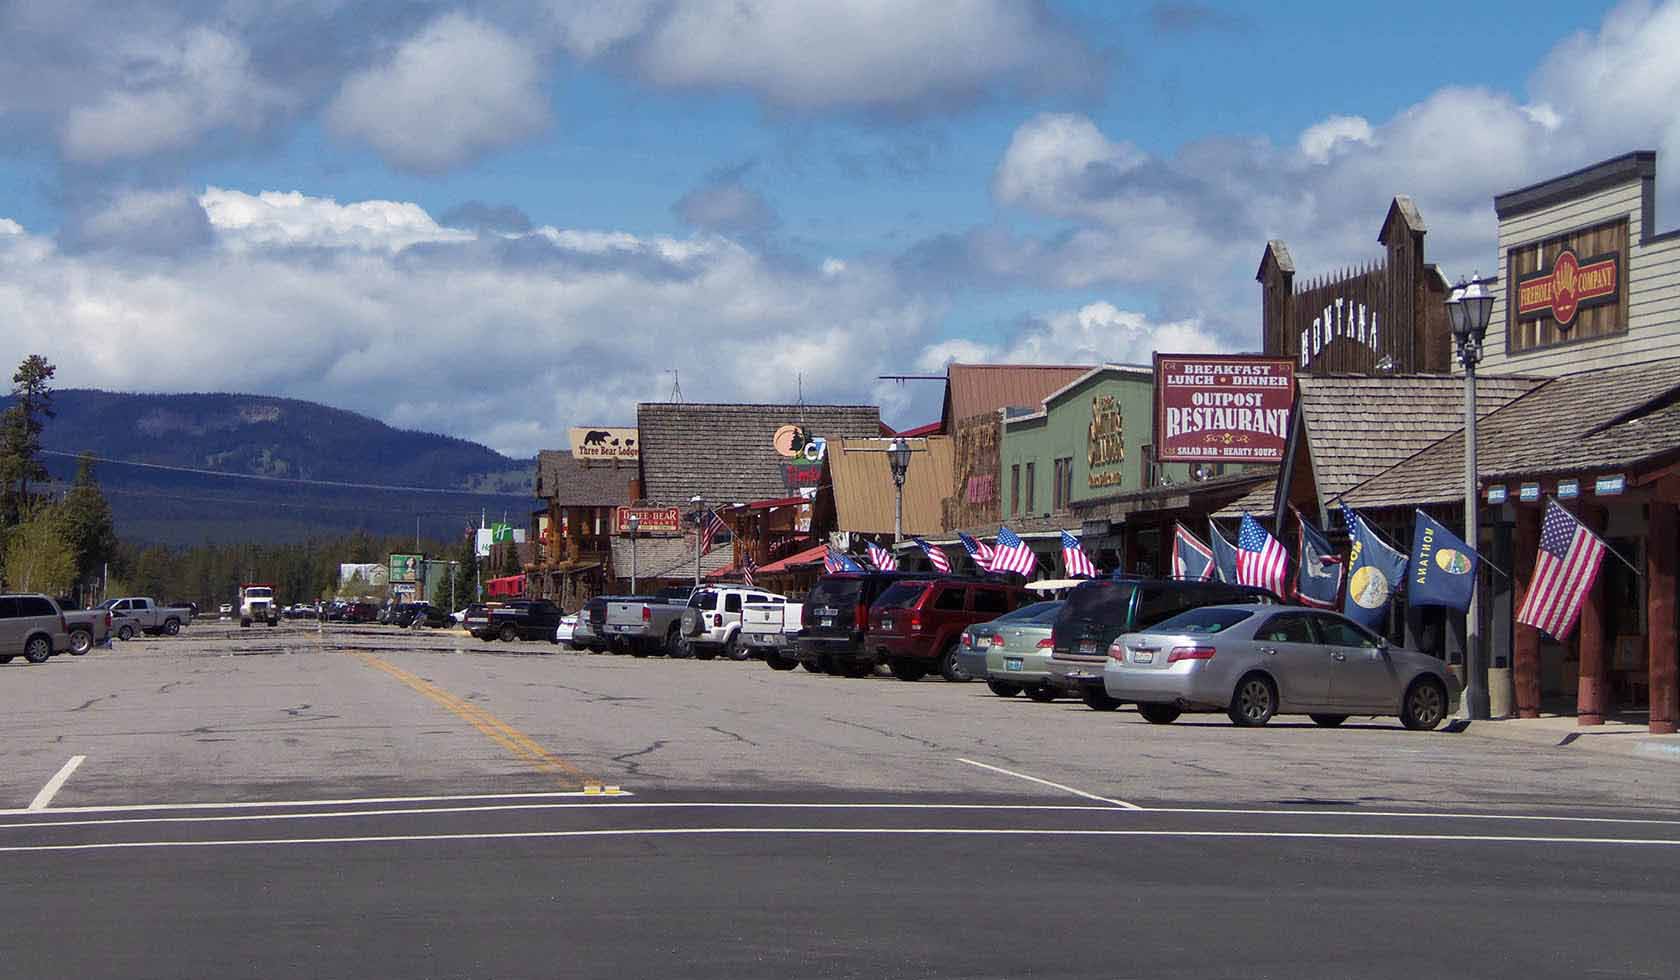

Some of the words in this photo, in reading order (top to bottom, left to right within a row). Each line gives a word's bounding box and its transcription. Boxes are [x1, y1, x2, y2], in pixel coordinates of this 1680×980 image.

[1578, 267, 1612, 292] COMPANY
[1301, 297, 1377, 367] MONTANA
[1184, 365, 1271, 375] BREAKFAST
[1167, 375, 1214, 385] LUNCH
[1232, 376, 1288, 385] DINNER
[1191, 392, 1263, 407] OUTPOST
[1166, 407, 1289, 440] RESTAURANT
[579, 446, 599, 455] Three
[601, 446, 617, 455] Bear
[1177, 447, 1201, 456] SALAD
[1202, 447, 1218, 456] BAR
[1223, 448, 1252, 456] HEARTY
[1254, 448, 1277, 456] SOUPS
[652, 510, 677, 521] BEAR
